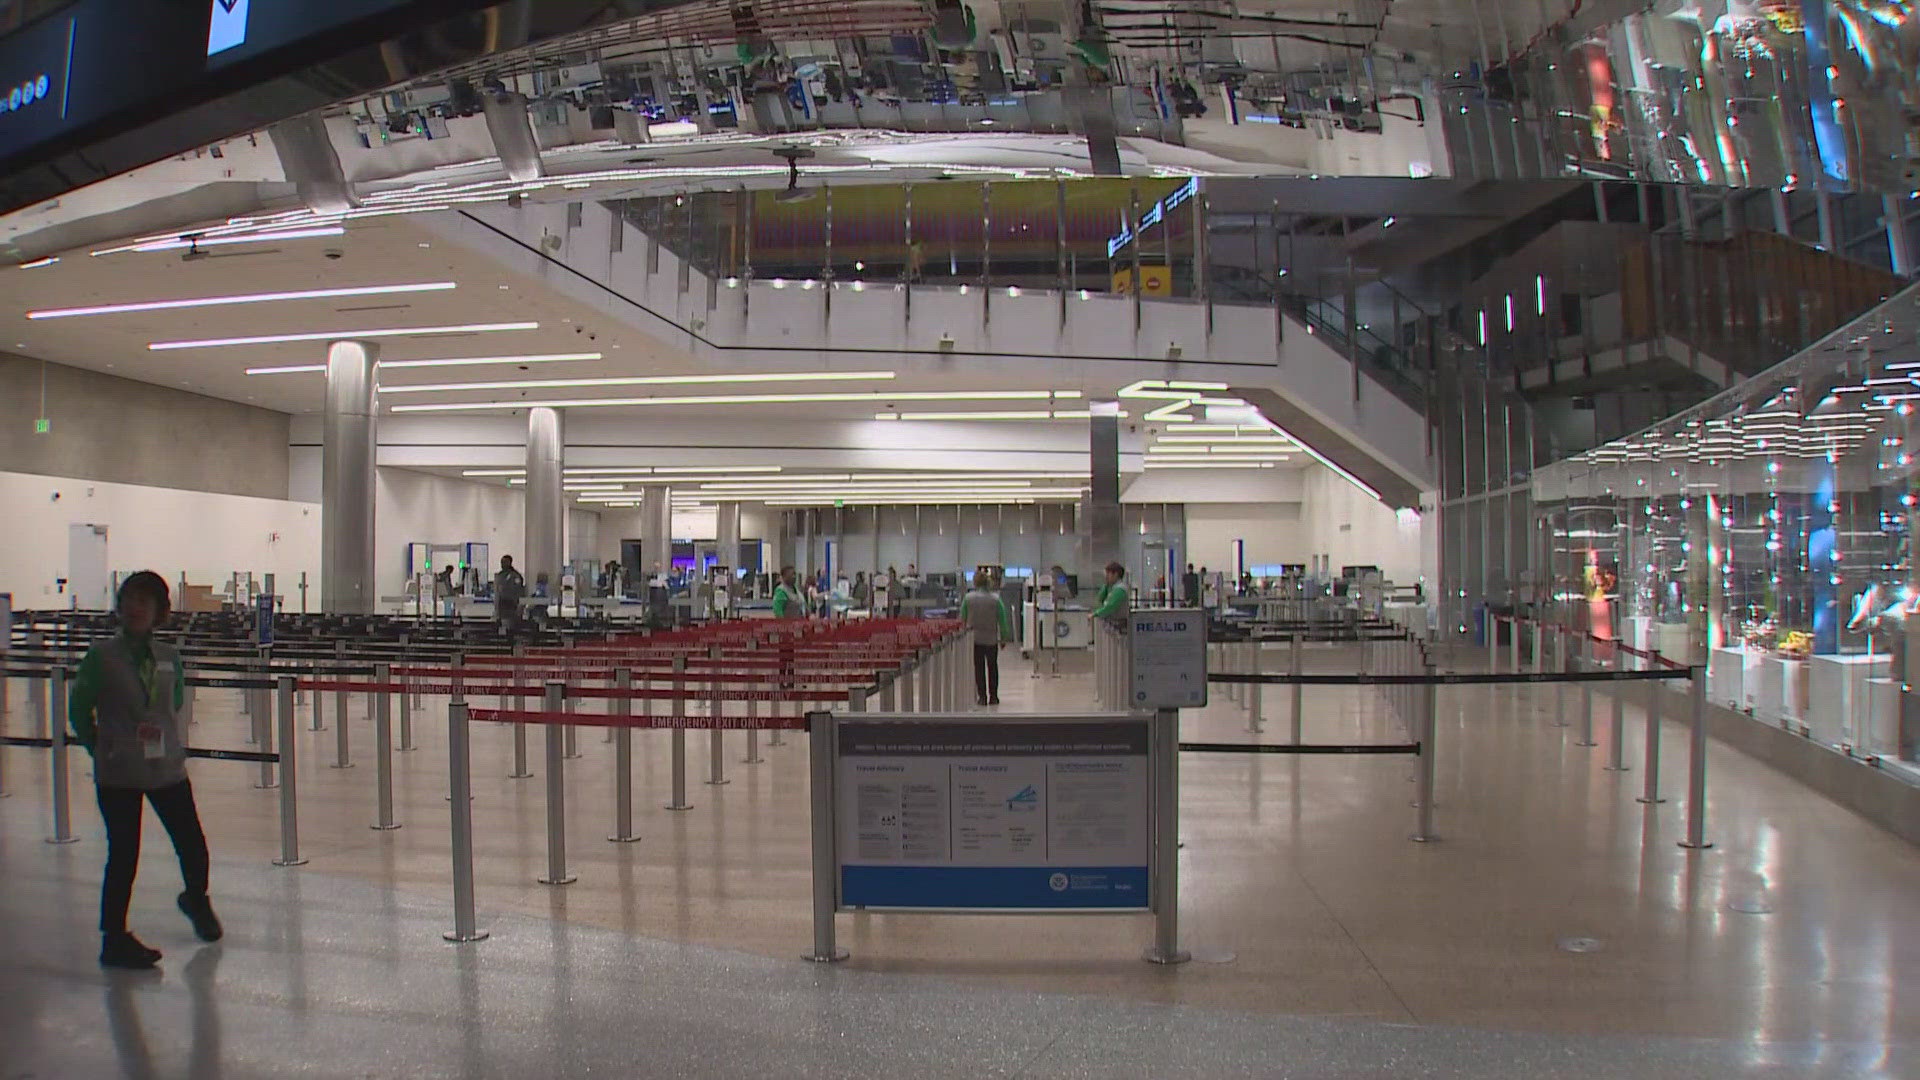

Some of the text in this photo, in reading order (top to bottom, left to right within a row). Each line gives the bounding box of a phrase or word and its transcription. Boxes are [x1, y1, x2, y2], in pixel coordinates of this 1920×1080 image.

[1136, 622, 1187, 632] REAL ID
[405, 684, 490, 695] EMERGENCY EXIT ONLY
[694, 691, 791, 701] EMERGENCY EXIT ONLY
[652, 717, 766, 729] EMERGENCY EXIT ONLY
